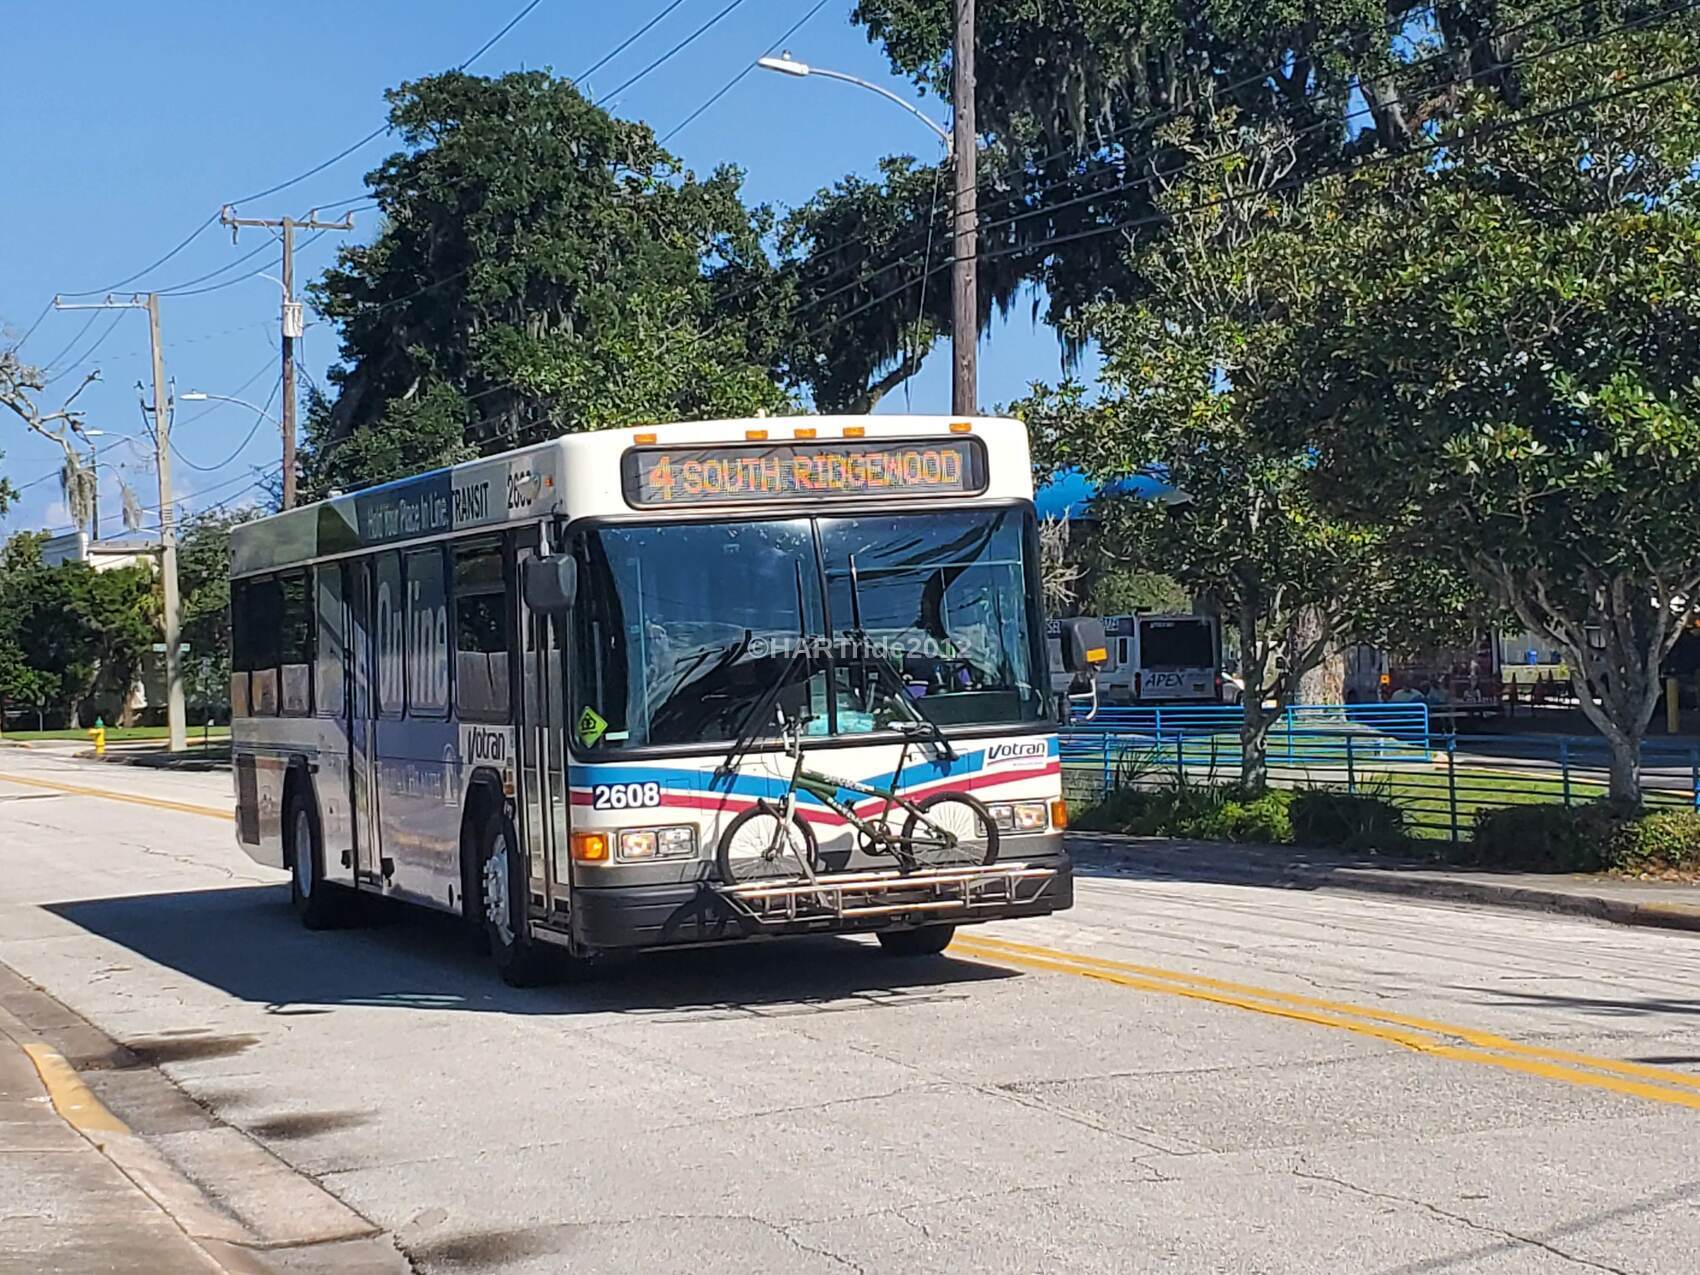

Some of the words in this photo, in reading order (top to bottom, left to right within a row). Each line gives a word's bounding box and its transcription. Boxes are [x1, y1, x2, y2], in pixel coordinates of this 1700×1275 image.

[649, 456, 676, 500] 4
[683, 457, 782, 494] SOUTH
[793, 449, 963, 489] RIDGEWOOD
[452, 481, 489, 522] RANSIT
[1145, 672, 1185, 688] APEX
[467, 726, 506, 766] Votran
[988, 743, 1045, 760] Votran
[595, 781, 660, 809] 2608
